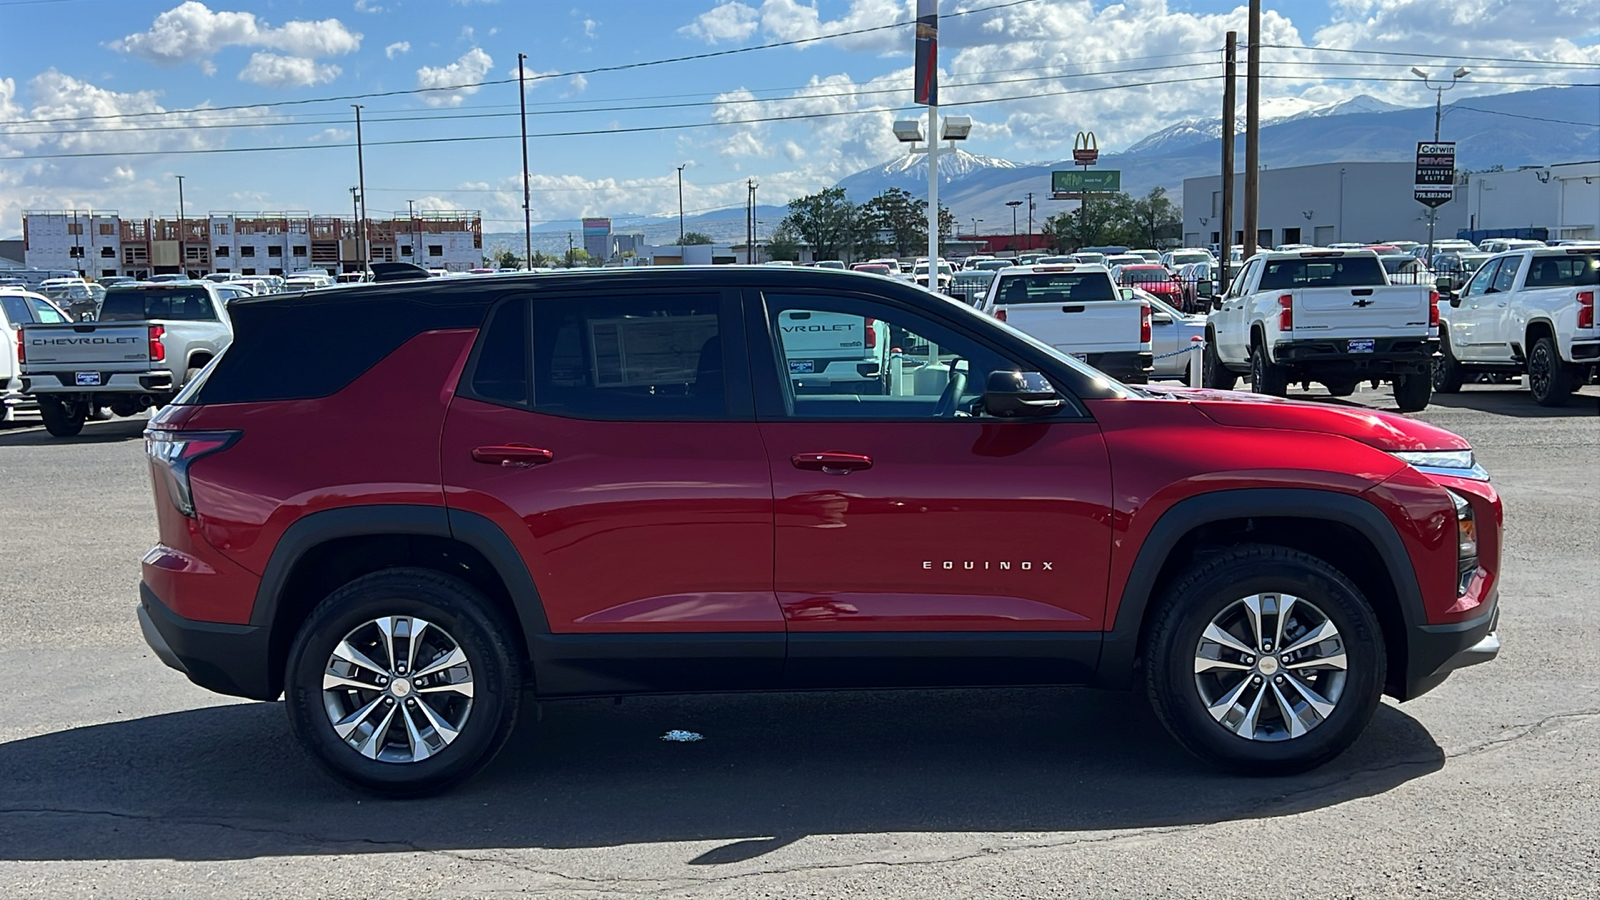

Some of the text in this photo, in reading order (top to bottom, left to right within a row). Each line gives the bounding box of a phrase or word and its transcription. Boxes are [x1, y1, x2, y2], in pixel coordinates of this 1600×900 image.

[1421, 145, 1455, 154] Corwin
[1418, 157, 1453, 165] GMC
[32, 337, 139, 346] CHEVROLET
[922, 561, 1053, 570] EQUINOX
